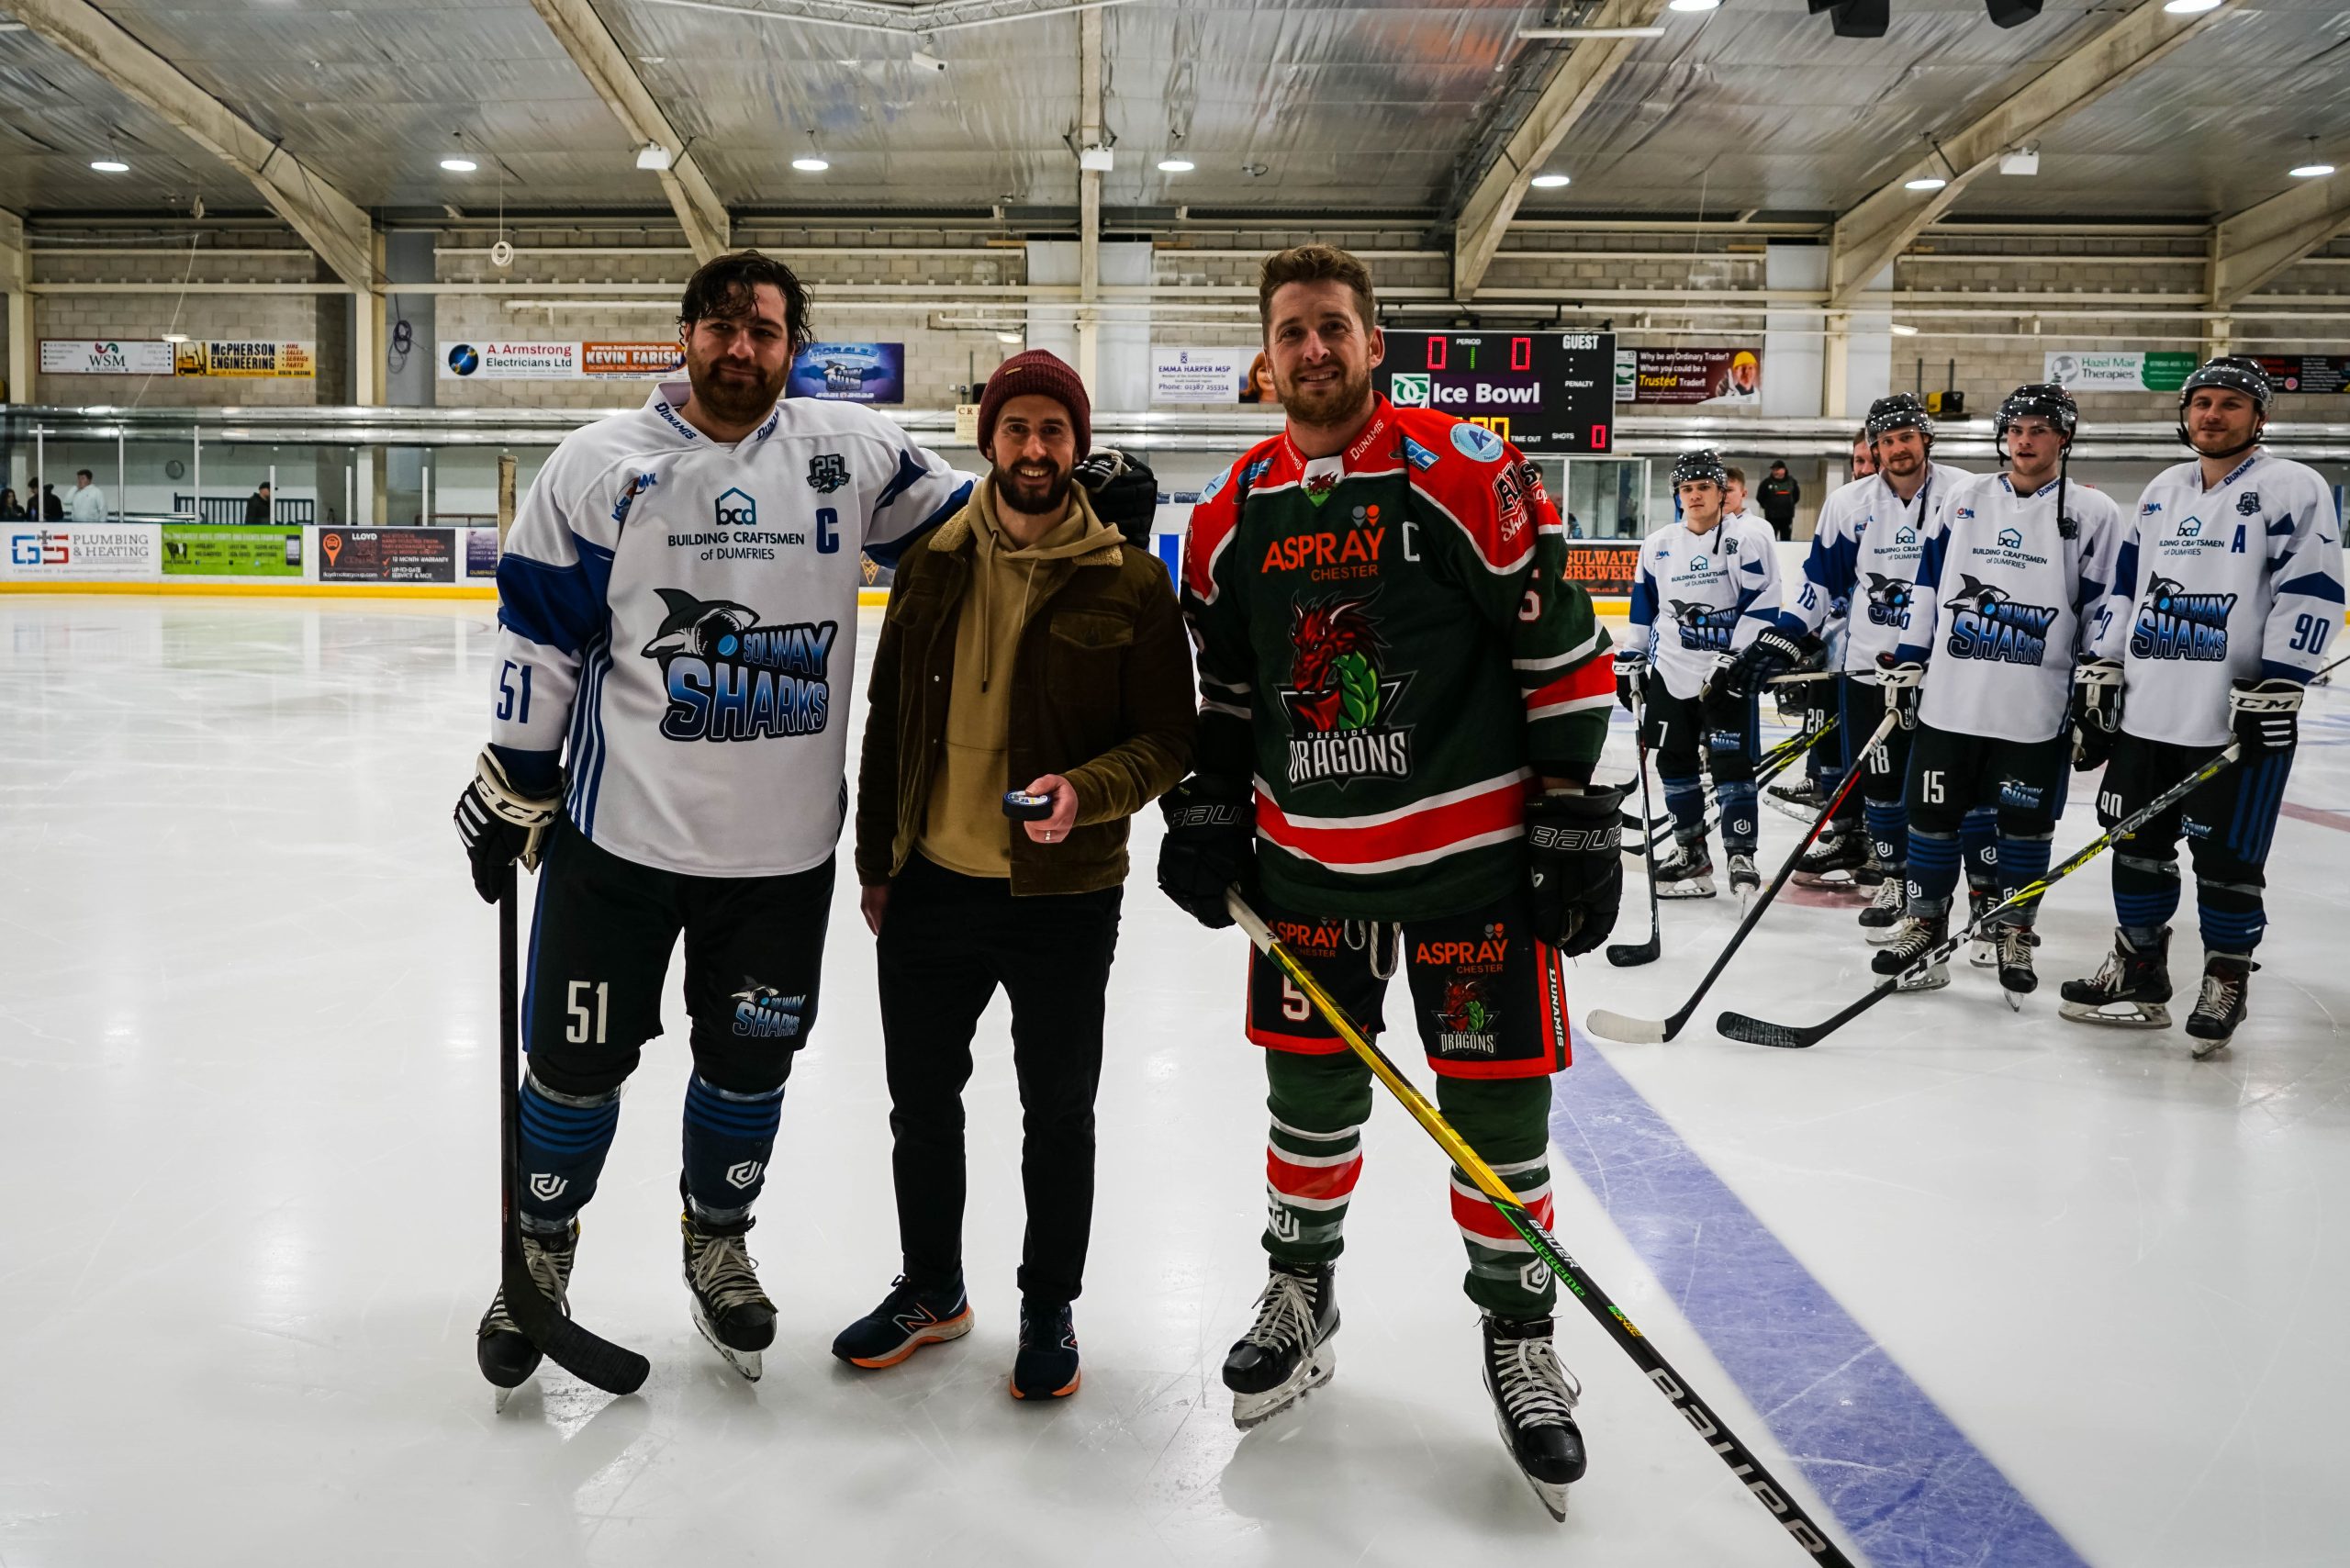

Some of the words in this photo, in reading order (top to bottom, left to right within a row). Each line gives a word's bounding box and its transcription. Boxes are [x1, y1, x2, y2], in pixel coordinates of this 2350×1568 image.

[211, 343, 274, 355] McPHERSON
[487, 344, 499, 354] A.
[503, 344, 571, 356] Armstrong
[1427, 337, 1447, 369] 0
[1511, 338, 1531, 370] 0
[1562, 335, 1599, 350] GUEST
[88, 354, 125, 366] WSM
[211, 357, 274, 369] ENGINEERING
[487, 357, 551, 367] Electricians
[554, 357, 571, 367] Ltd
[586, 352, 627, 364] KEVIN
[632, 352, 682, 364] FARISH
[1471, 347, 1476, 368] 1
[1639, 353, 1655, 361] Why
[1674, 353, 1703, 362] Ordinary
[2082, 358, 2109, 366] Hazel
[2113, 358, 2137, 366] Mair
[1639, 375, 1678, 386] Trusted
[2082, 369, 2134, 379] Therapies
[1433, 383, 1469, 403] Ice
[1476, 382, 1539, 403] Bowl
[655, 401, 698, 440] DUNAMIS
[1349, 420, 1384, 460] DUNAMIS
[1592, 425, 1606, 448] 0
[814, 454, 841, 473] 25
[715, 497, 756, 526] bcd
[73, 534, 149, 544] PLUMBING
[667, 532, 729, 546] BUILDING
[733, 532, 804, 545] CRAFTSMEN
[815, 508, 840, 554] C
[1402, 521, 1421, 562] C
[2231, 524, 2245, 553] A
[73, 547, 82, 556] &
[86, 547, 149, 556] HEATING
[700, 549, 713, 560] of
[717, 548, 775, 560] DUMFRIES
[1261, 527, 1386, 574] ASPRAY
[1973, 547, 2000, 556] BUILDING
[2003, 550, 2048, 565] CRAFTSMEN
[1993, 558, 2026, 569] DUMFRIES
[1311, 565, 1379, 581] CHESTER
[1562, 565, 1637, 580] BREWER
[1797, 583, 1817, 610] 18
[1998, 603, 2055, 633] SOLWAY
[2173, 596, 2234, 627] SOLWAY
[1950, 610, 2044, 666] SHARKS
[2132, 609, 2228, 660] SHARKS
[2288, 613, 2330, 655] 90
[742, 625, 834, 676] SOLWAY
[497, 659, 532, 724] 51
[664, 656, 827, 739] SHARKS
[1308, 728, 1368, 739] DEESIDE
[1658, 721, 1669, 747] 7
[1288, 732, 1408, 782] DRAGONS
[1923, 770, 1945, 803] 15
[2063, 845, 2103, 875] SUPER
[1416, 939, 1509, 964] ASPRAY
[1456, 964, 1503, 975] CHESTER
[1282, 973, 1311, 1021] 5
[1548, 968, 1565, 1047] DUNAMIS
[566, 980, 608, 1044] 51
[733, 1001, 800, 1037] SHARKS
[1440, 1034, 1495, 1054] DRAGONS
[1528, 1219, 1580, 1268] BAUER
[1646, 1367, 1828, 1555] BAUER
